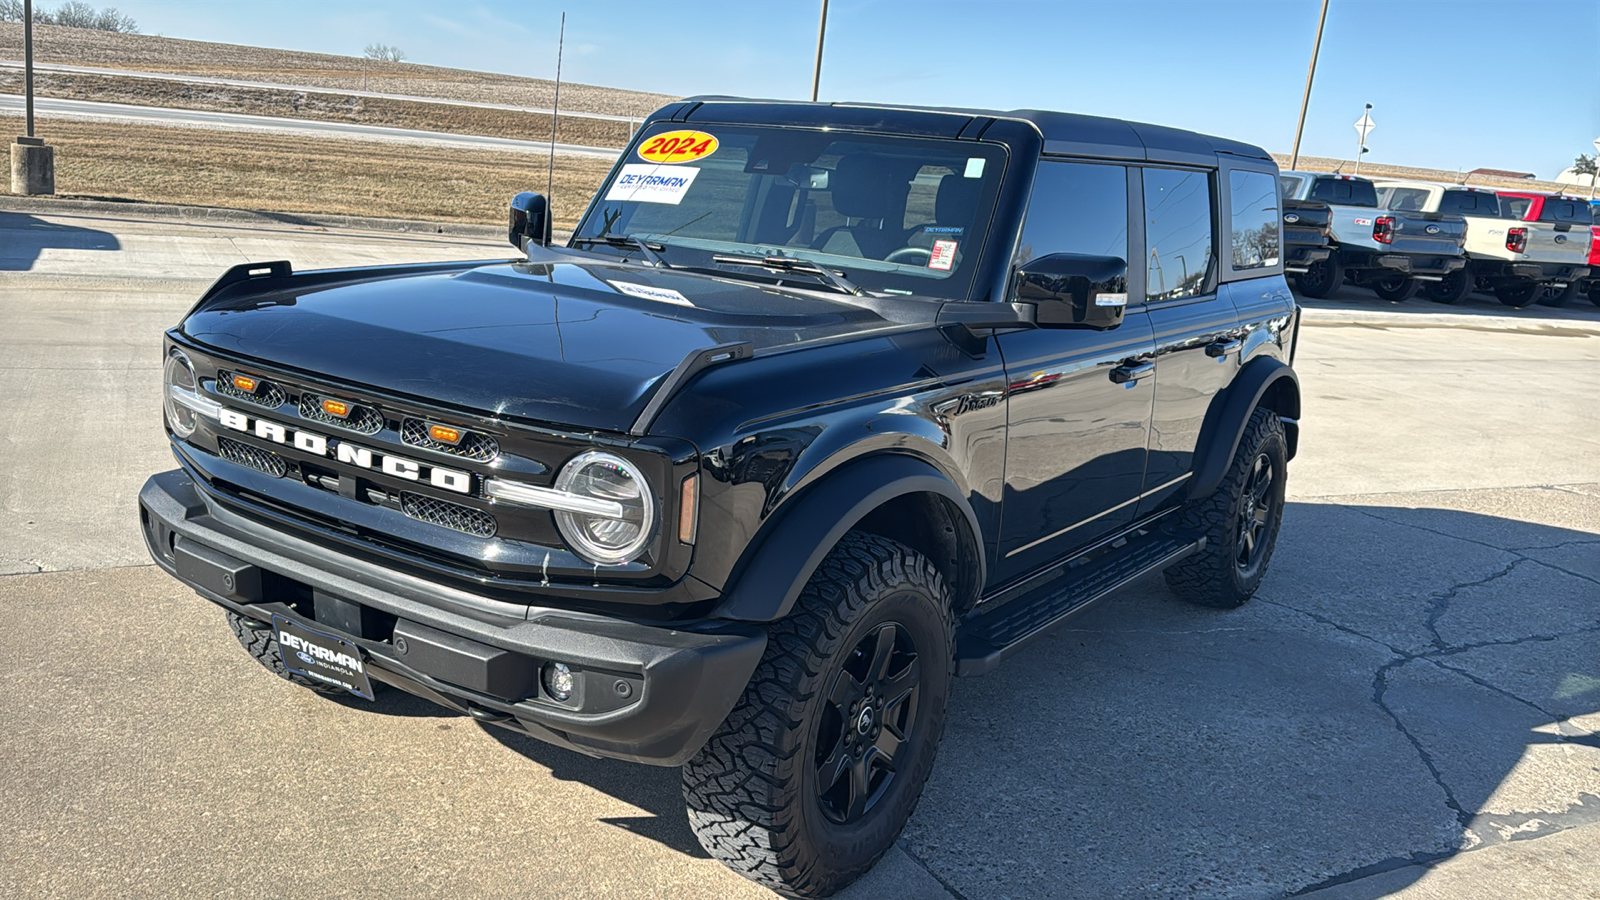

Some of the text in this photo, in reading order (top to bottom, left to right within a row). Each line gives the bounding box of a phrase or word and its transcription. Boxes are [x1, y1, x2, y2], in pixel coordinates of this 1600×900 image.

[642, 137, 713, 156] 2024
[619, 174, 689, 188] DEYARMAN
[219, 407, 471, 495] BRONCO
[279, 630, 363, 673] DEYARMAN
